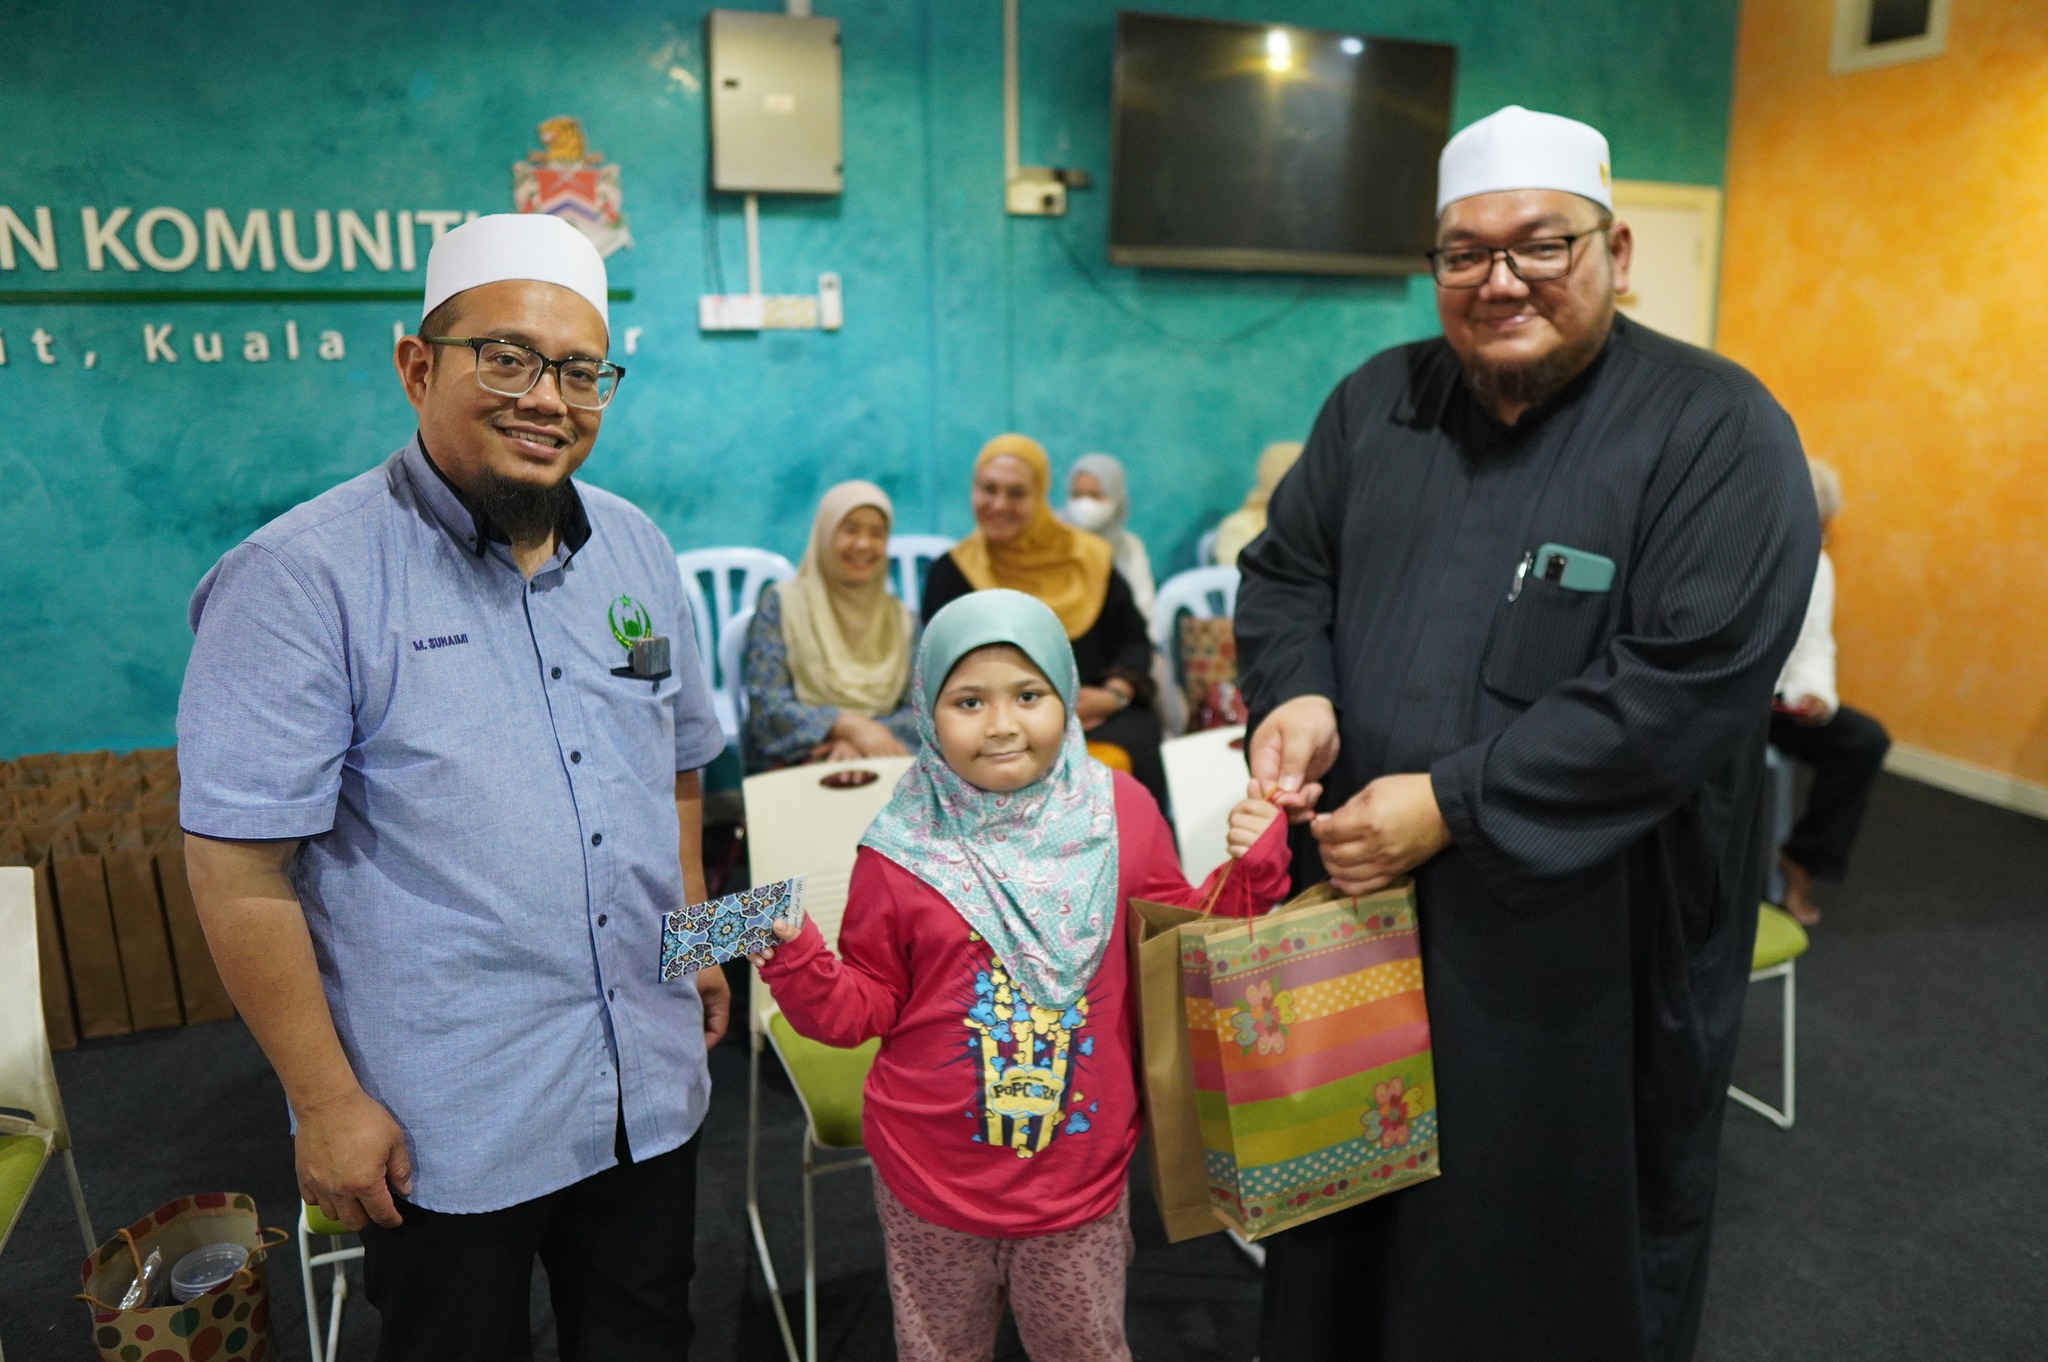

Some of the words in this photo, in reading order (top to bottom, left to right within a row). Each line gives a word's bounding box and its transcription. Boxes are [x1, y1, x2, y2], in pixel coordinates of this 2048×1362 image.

[81, 206, 480, 272] KOMUNIT
[143, 319, 345, 363] Kuala
[413, 640, 428, 651] M.
[428, 633, 469, 649] SUHAIMI
